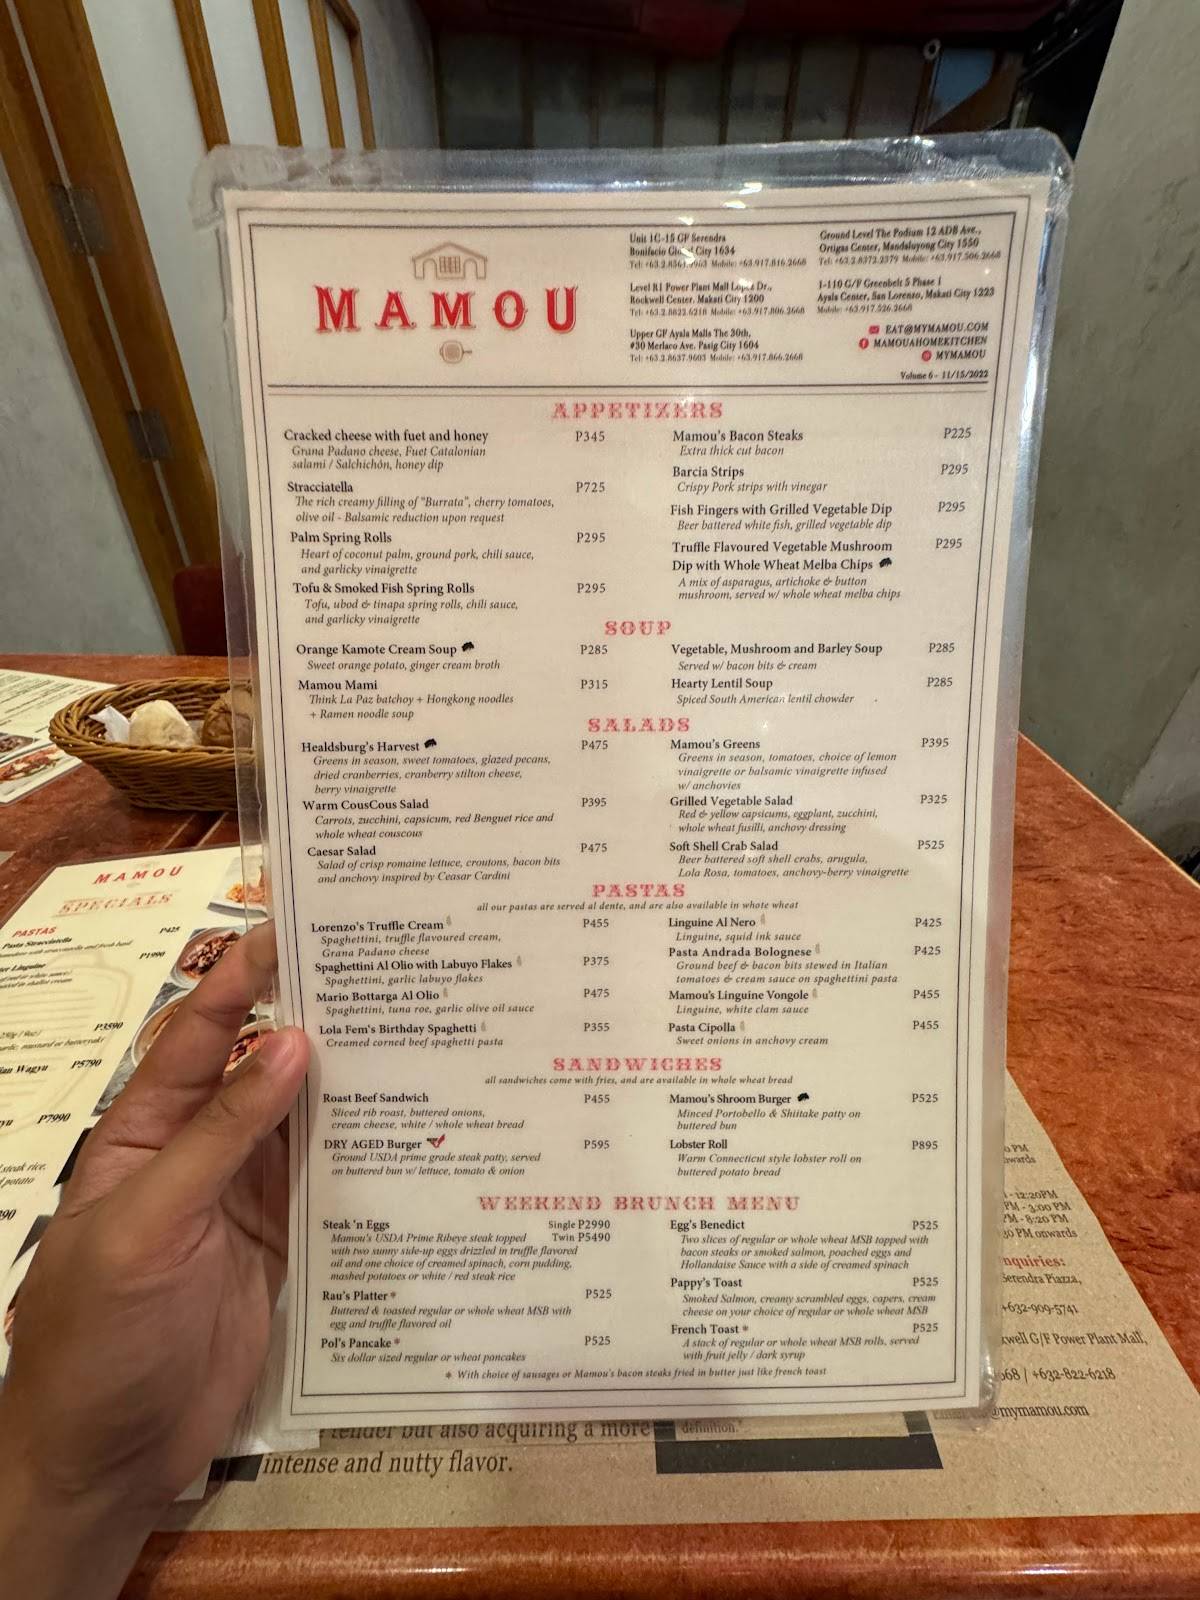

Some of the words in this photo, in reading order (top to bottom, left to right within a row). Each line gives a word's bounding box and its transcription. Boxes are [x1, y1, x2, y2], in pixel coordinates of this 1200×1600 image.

[313, 284, 578, 334] MAMOU
[630, 328, 653, 339] Upper
[714, 328, 728, 338] The
[885, 322, 989, 334] EAT@MYMAMOU.COM
[720, 341, 736, 351] City
[873, 336, 987, 348] MAMOUAHOMEKITCHEN
[936, 349, 986, 360] MYMAMOU
[900, 371, 927, 380] Volume
[551, 402, 724, 419] APPETIZERS
[284, 429, 332, 441] Cracked
[335, 429, 373, 441] cheese
[374, 429, 400, 441] with
[403, 429, 426, 441] fuet
[429, 429, 450, 441] and
[451, 429, 488, 444] honey
[575, 431, 605, 442] P345
[673, 430, 726, 442] Mamou's
[729, 430, 764, 441] Bacon
[767, 429, 803, 441] Steaks
[942, 427, 972, 440] P225
[292, 445, 324, 456] Grana
[327, 445, 367, 456] Padano
[367, 445, 401, 457] cheese,
[405, 445, 427, 456] Fuet
[430, 445, 485, 456] Catalonian
[670, 466, 708, 477] Barcia
[711, 466, 744, 479] Strips
[287, 481, 354, 493] Stracciatella
[574, 482, 605, 493] P725
[290, 531, 320, 542] Palm
[322, 532, 361, 544] Spring
[363, 531, 392, 543] Rolls
[577, 532, 605, 543] P295
[577, 583, 605, 593] P295
[604, 620, 672, 636] SOUP
[296, 644, 338, 657] Orange
[341, 644, 385, 654] Kamote
[388, 644, 426, 654] Cream
[429, 644, 457, 657] Soup
[581, 644, 608, 655] P285
[298, 680, 341, 690] Mamou
[345, 680, 377, 690] Mami
[581, 679, 608, 689] P315
[588, 717, 691, 733] SALADS
[302, 741, 374, 754] Healdsburg's
[377, 742, 419, 751] Harvest
[579, 740, 608, 751] P475
[669, 739, 720, 749] Mamou's
[723, 739, 760, 749] Greens
[921, 738, 949, 747] P395
[302, 801, 339, 810] Warm
[339, 800, 397, 810] CousCous
[399, 799, 429, 809] Salad
[580, 798, 608, 807] P395
[93, 865, 184, 884] MAMOU
[592, 883, 686, 898] PASTAS
[58, 893, 173, 914] SPECIALS
[582, 919, 611, 928] P455
[667, 918, 713, 929] Linguine
[715, 917, 729, 927] Al
[730, 917, 756, 927] Nero
[915, 918, 942, 927] P425
[12, 926, 57, 938] PASTAS
[912, 989, 939, 999] P455
[668, 1023, 695, 1032] Pasta
[698, 1022, 735, 1035] Cipolla
[553, 1057, 723, 1072] SANDWICHES
[323, 1094, 352, 1103] Roast
[354, 1093, 378, 1103] Beef
[379, 1093, 429, 1103] Sandwich
[37, 1113, 71, 1124] P7990
[323, 1139, 347, 1149] DRY
[351, 1139, 384, 1149] AGED
[387, 1139, 422, 1151] Burger
[582, 1140, 610, 1149] P595
[670, 1139, 705, 1149] Lobster
[708, 1139, 728, 1149] Roll
[912, 1140, 938, 1150] P895
[478, 1196, 602, 1211] WEEKEND
[613, 1196, 716, 1211] BRUNCH
[727, 1196, 801, 1211] MENU
[1054, 1202, 1072, 1211] PM
[1052, 1214, 1069, 1223] PM
[323, 1219, 351, 1229] Steak
[353, 1220, 363, 1229] 'n
[365, 1220, 390, 1232] Eggs
[549, 1220, 576, 1231] Single
[576, 1219, 610, 1229] P2990
[670, 1219, 696, 1232] Egg's
[700, 1219, 744, 1229] Benedict
[911, 1220, 939, 1230] P525
[552, 1233, 574, 1242] Twin
[577, 1232, 610, 1242] P5490
[1018, 1228, 1034, 1239] PM
[1035, 1228, 1078, 1239] onwards
[1003, 1255, 1066, 1270] nquiries:
[670, 1277, 710, 1290] Pappy's
[713, 1277, 742, 1287] Toast
[912, 1277, 938, 1287] P525
[322, 1291, 350, 1301] Rau's
[353, 1290, 388, 1301] Platter
[586, 1289, 614, 1299] P525
[671, 1324, 707, 1334] French
[710, 1324, 740, 1334] Toast
[912, 1323, 938, 1333] P525
[585, 1336, 612, 1346] P525
[1029, 1332, 1050, 1347] G/F
[1053, 1332, 1087, 1345] Power
[1088, 1332, 1118, 1345] Plant
[1032, 1367, 1116, 1382] +632-822-6218
[485, 1421, 577, 1443] acquiring
[584, 1423, 594, 1437] a
[601, 1421, 651, 1437] more
[262, 1453, 339, 1474] intense
[344, 1451, 382, 1473] and
[388, 1452, 443, 1478] nutty
[449, 1450, 514, 1473] flavor.
